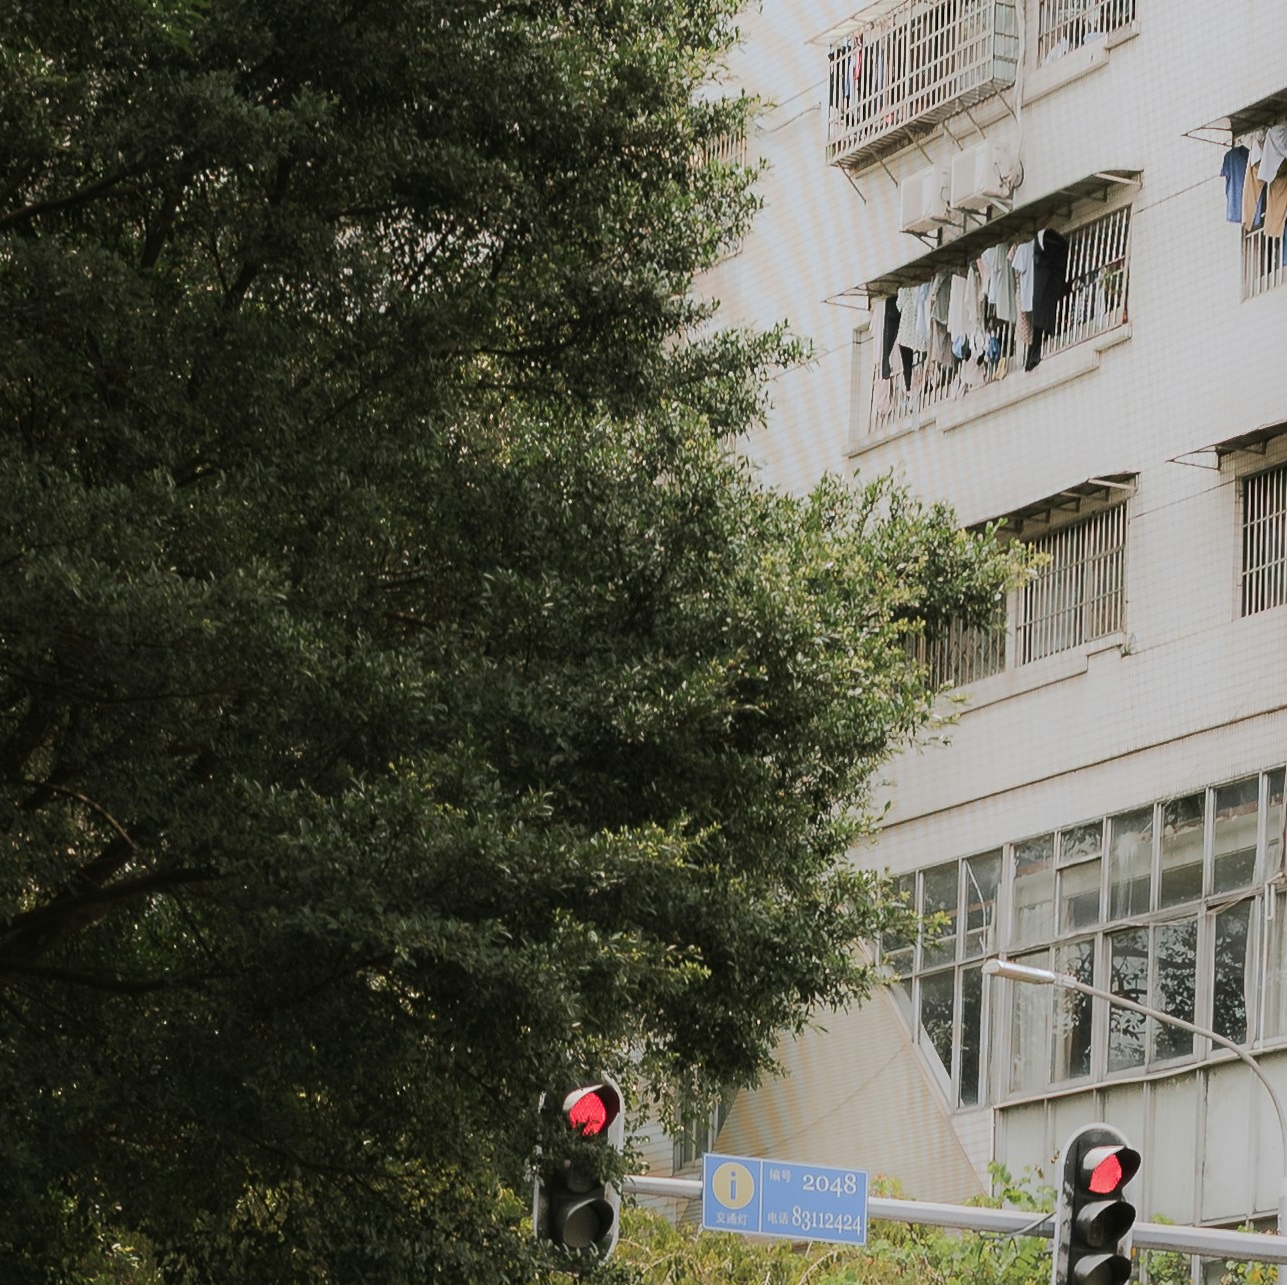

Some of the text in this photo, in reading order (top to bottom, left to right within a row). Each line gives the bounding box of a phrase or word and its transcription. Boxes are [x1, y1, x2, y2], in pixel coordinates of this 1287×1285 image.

[769, 1168, 857, 1197] 编号 2048
[716, 1211, 748, 1226] 交通灯
[767, 1205, 861, 1235] 电话 83112424
